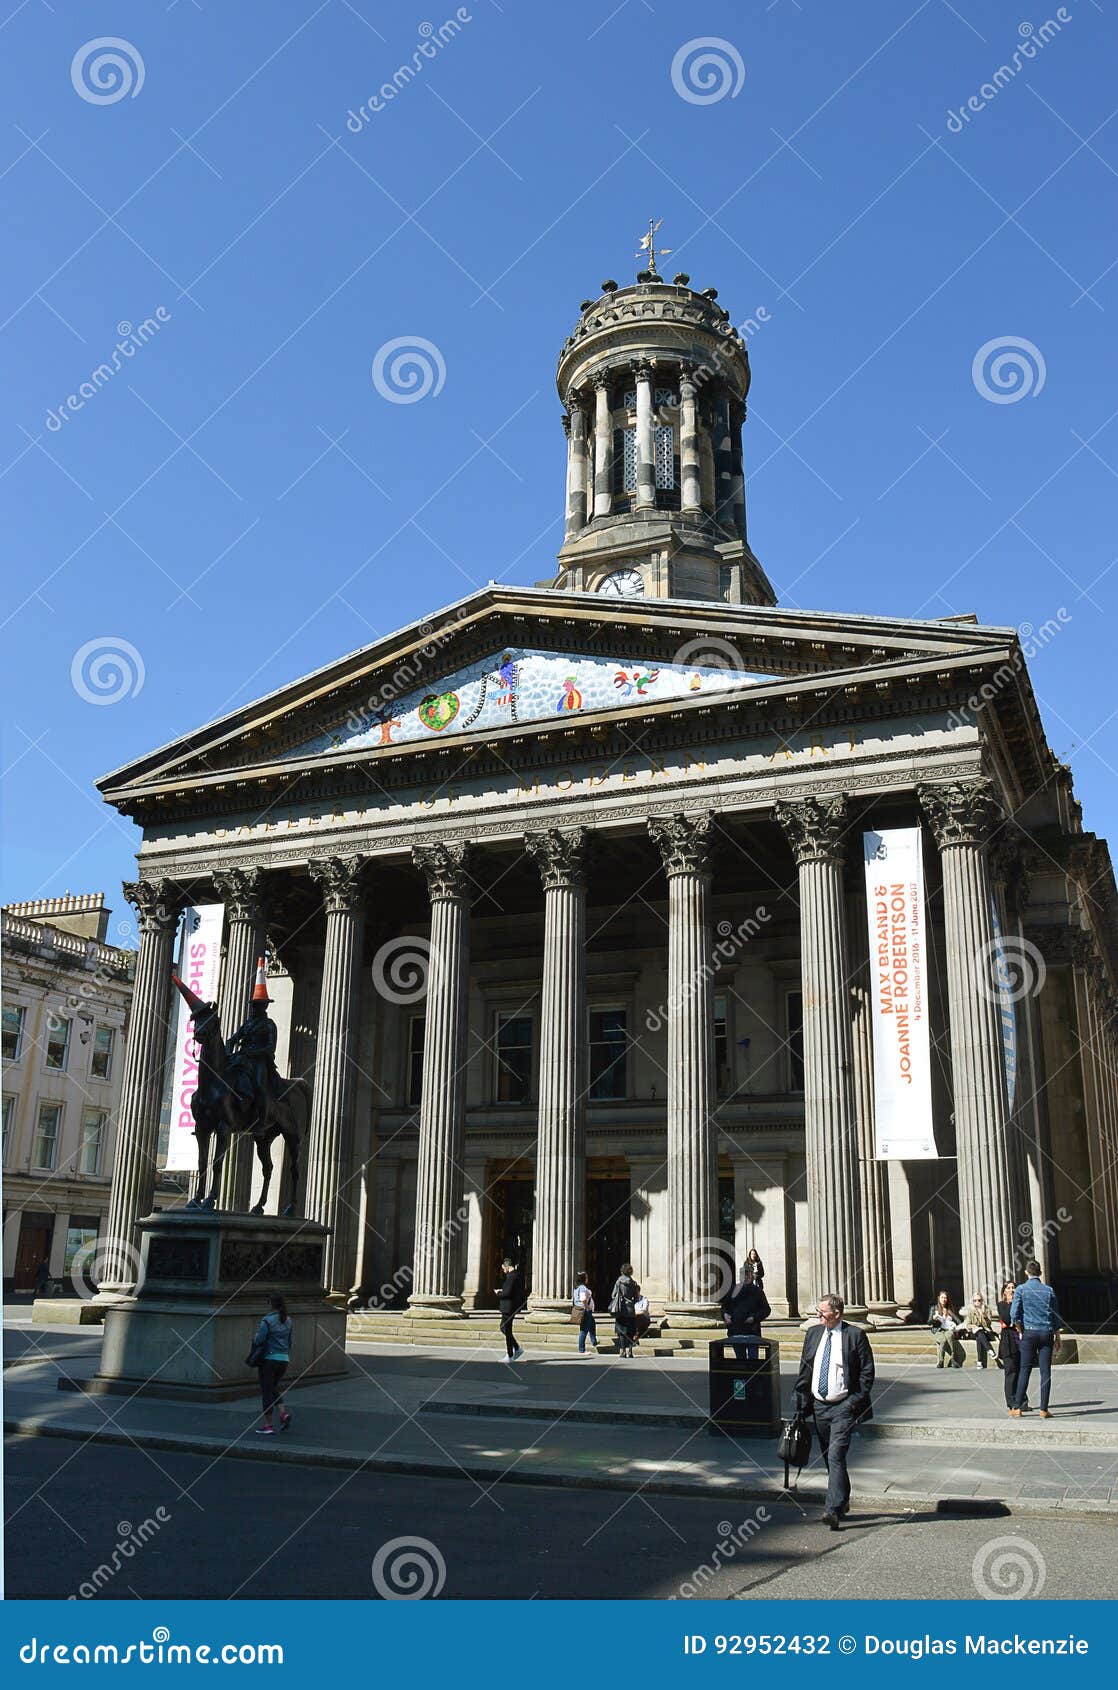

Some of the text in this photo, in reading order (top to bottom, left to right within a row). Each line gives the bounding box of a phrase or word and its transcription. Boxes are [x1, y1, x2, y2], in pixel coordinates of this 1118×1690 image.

[517, 751, 705, 797] MODERN
[769, 729, 862, 763] ART
[874, 884, 894, 1014] MAX BRAND &
[911, 904, 919, 926] June
[912, 943, 920, 963] 2016
[890, 884, 912, 1084] JOANNE ROBERTSON
[177, 942, 207, 1128] POLYGPHS
